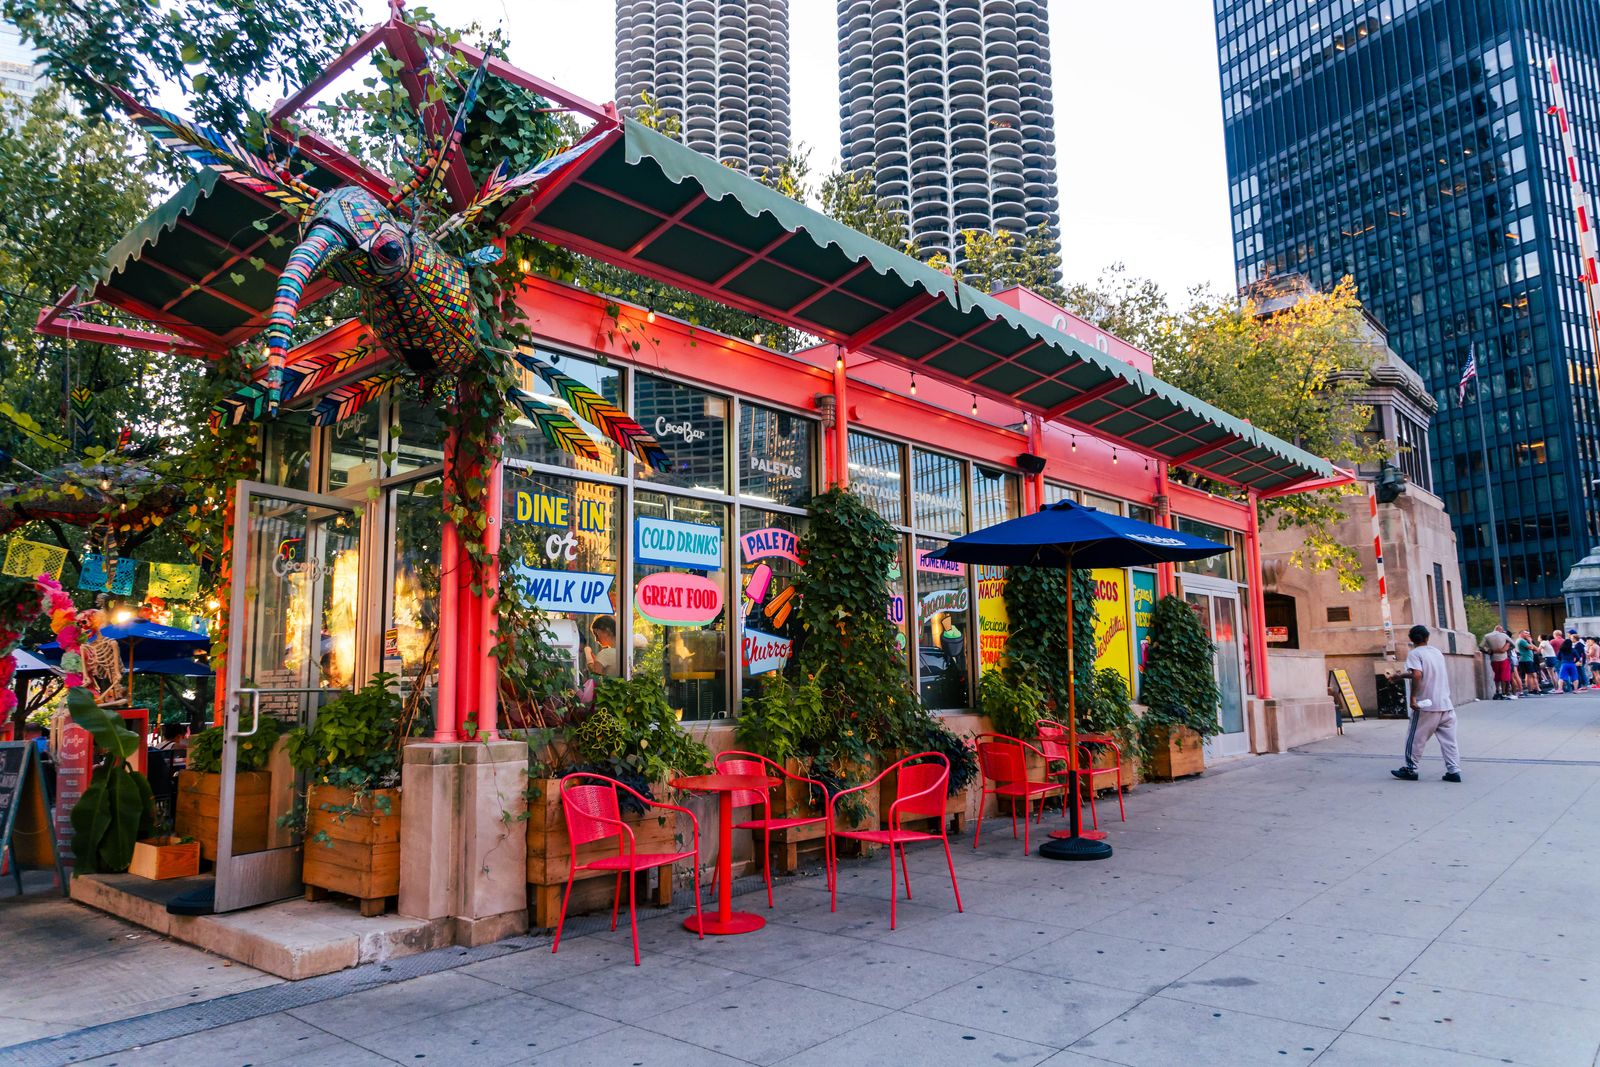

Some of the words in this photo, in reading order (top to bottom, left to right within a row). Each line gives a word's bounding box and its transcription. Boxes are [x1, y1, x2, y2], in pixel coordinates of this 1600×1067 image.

[655, 416, 706, 443] CocoBar
[751, 456, 802, 479] PALETAS
[515, 490, 570, 529] DINE
[579, 500, 606, 533] IN
[914, 491, 963, 511] EMPANADAS
[545, 531, 578, 561] or
[641, 526, 675, 551] COLD
[676, 531, 718, 556] DRINKS
[272, 552, 335, 583] CocoBar
[526, 577, 576, 603] WALK
[580, 581, 605, 605] UP
[642, 584, 684, 608] GREAT
[686, 588, 718, 610] FOOD
[978, 582, 1005, 600] NACHO
[1094, 579, 1119, 602] ACOS
[1096, 615, 1126, 659] uesadillas
[741, 635, 794, 668] Churros
